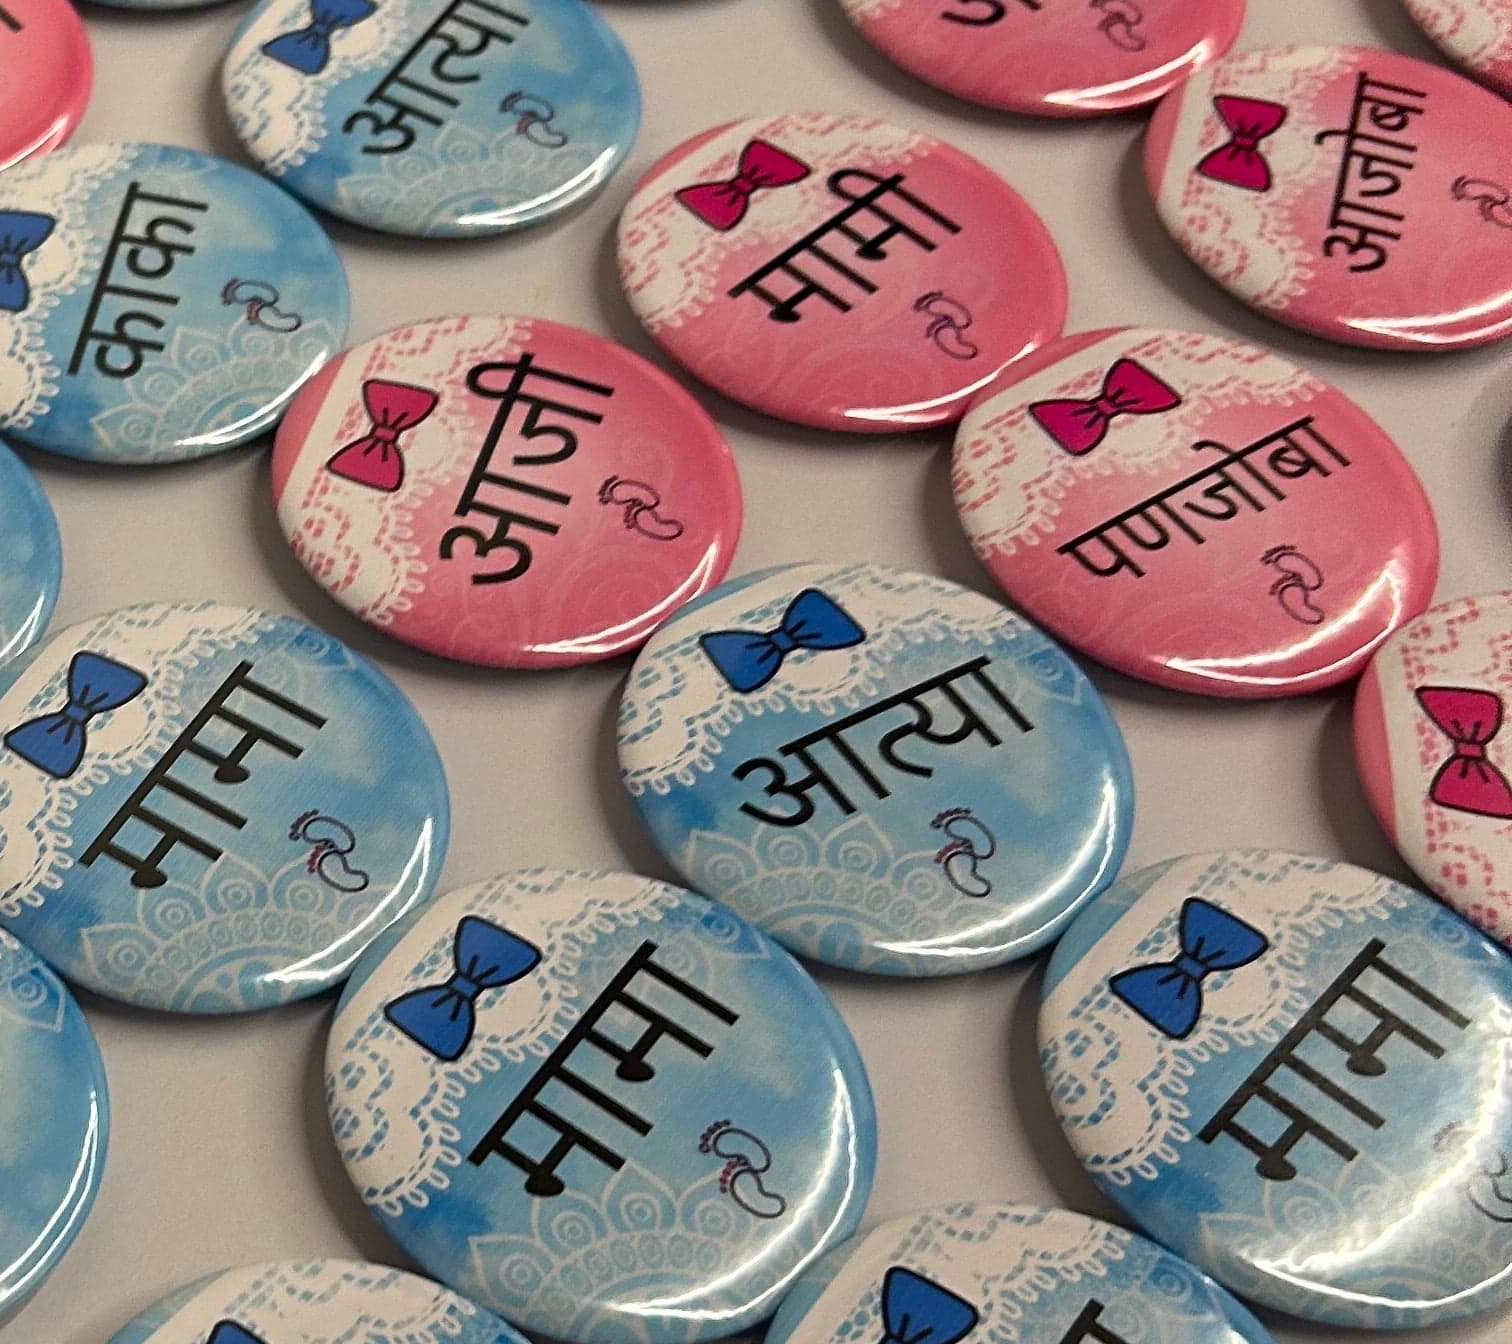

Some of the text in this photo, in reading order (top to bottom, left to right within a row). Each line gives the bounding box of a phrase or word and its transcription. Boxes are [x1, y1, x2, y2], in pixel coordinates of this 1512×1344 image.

[728, 167, 962, 324] मामी
[1315, 72, 1426, 272] आजोबा
[67, 180, 209, 380] काका
[439, 353, 615, 586] आजी
[1056, 415, 1351, 579] पणजोबा
[78, 660, 329, 889] मामा
[732, 656, 1036, 829] आत्या
[467, 939, 740, 1198] मामा
[1197, 938, 1473, 1182] मामा
